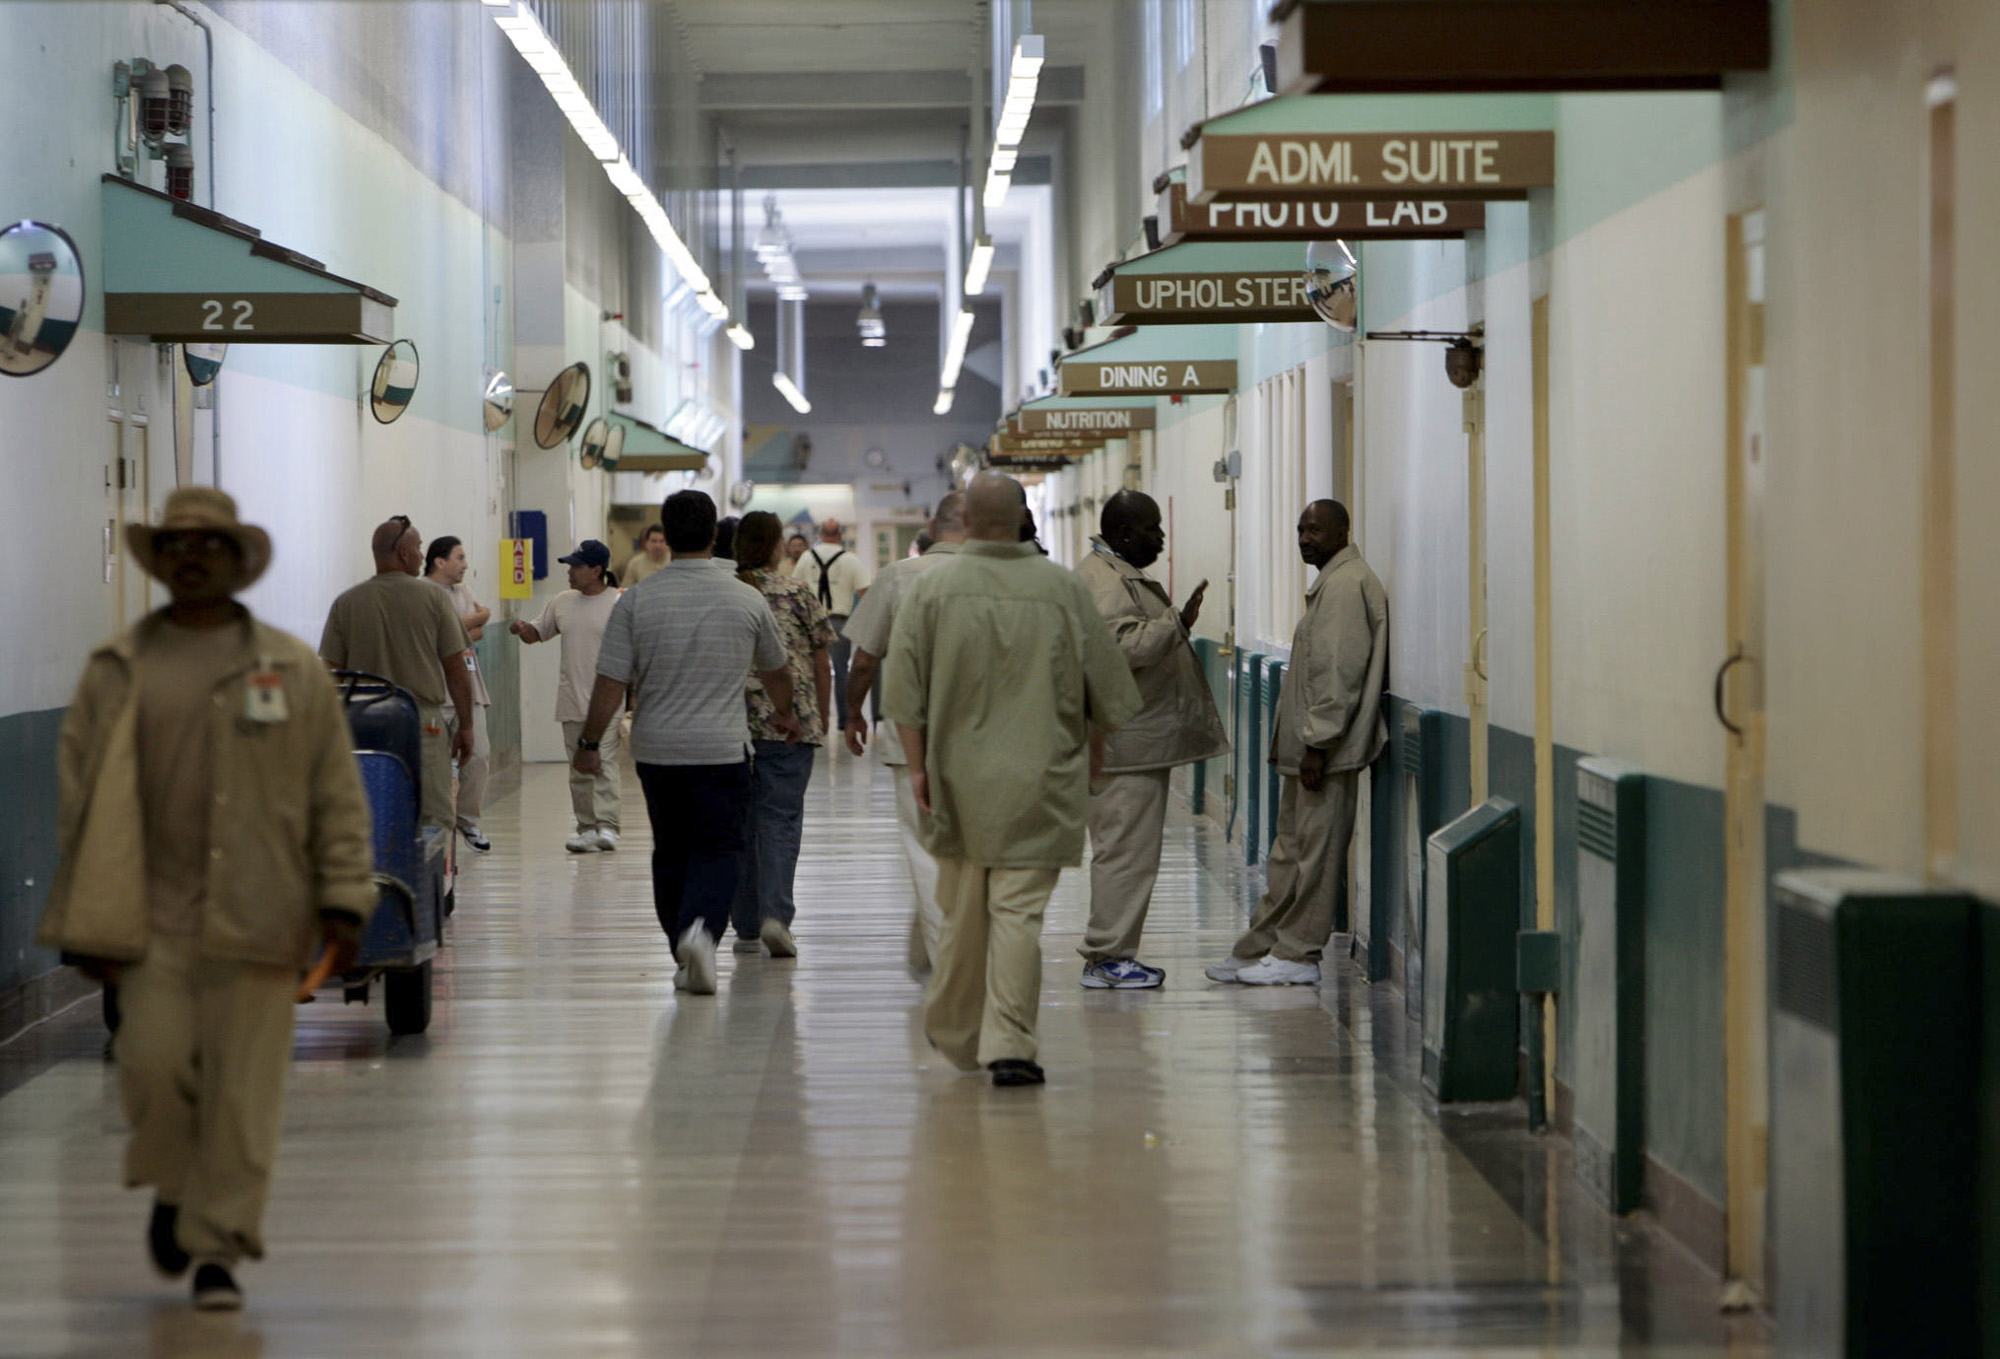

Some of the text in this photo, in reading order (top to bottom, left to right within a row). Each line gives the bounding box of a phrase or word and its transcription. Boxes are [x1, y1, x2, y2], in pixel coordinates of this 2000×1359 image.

[1247, 141, 1500, 184] ADMI. SUITE
[1366, 201, 1448, 226] LAB
[1136, 277, 1313, 309] UPHOLSTER
[202, 300, 254, 330] 22
[1100, 365, 1200, 388] DINING A
[1046, 411, 1131, 429] NUTRITION
[514, 541, 525, 583] AED
